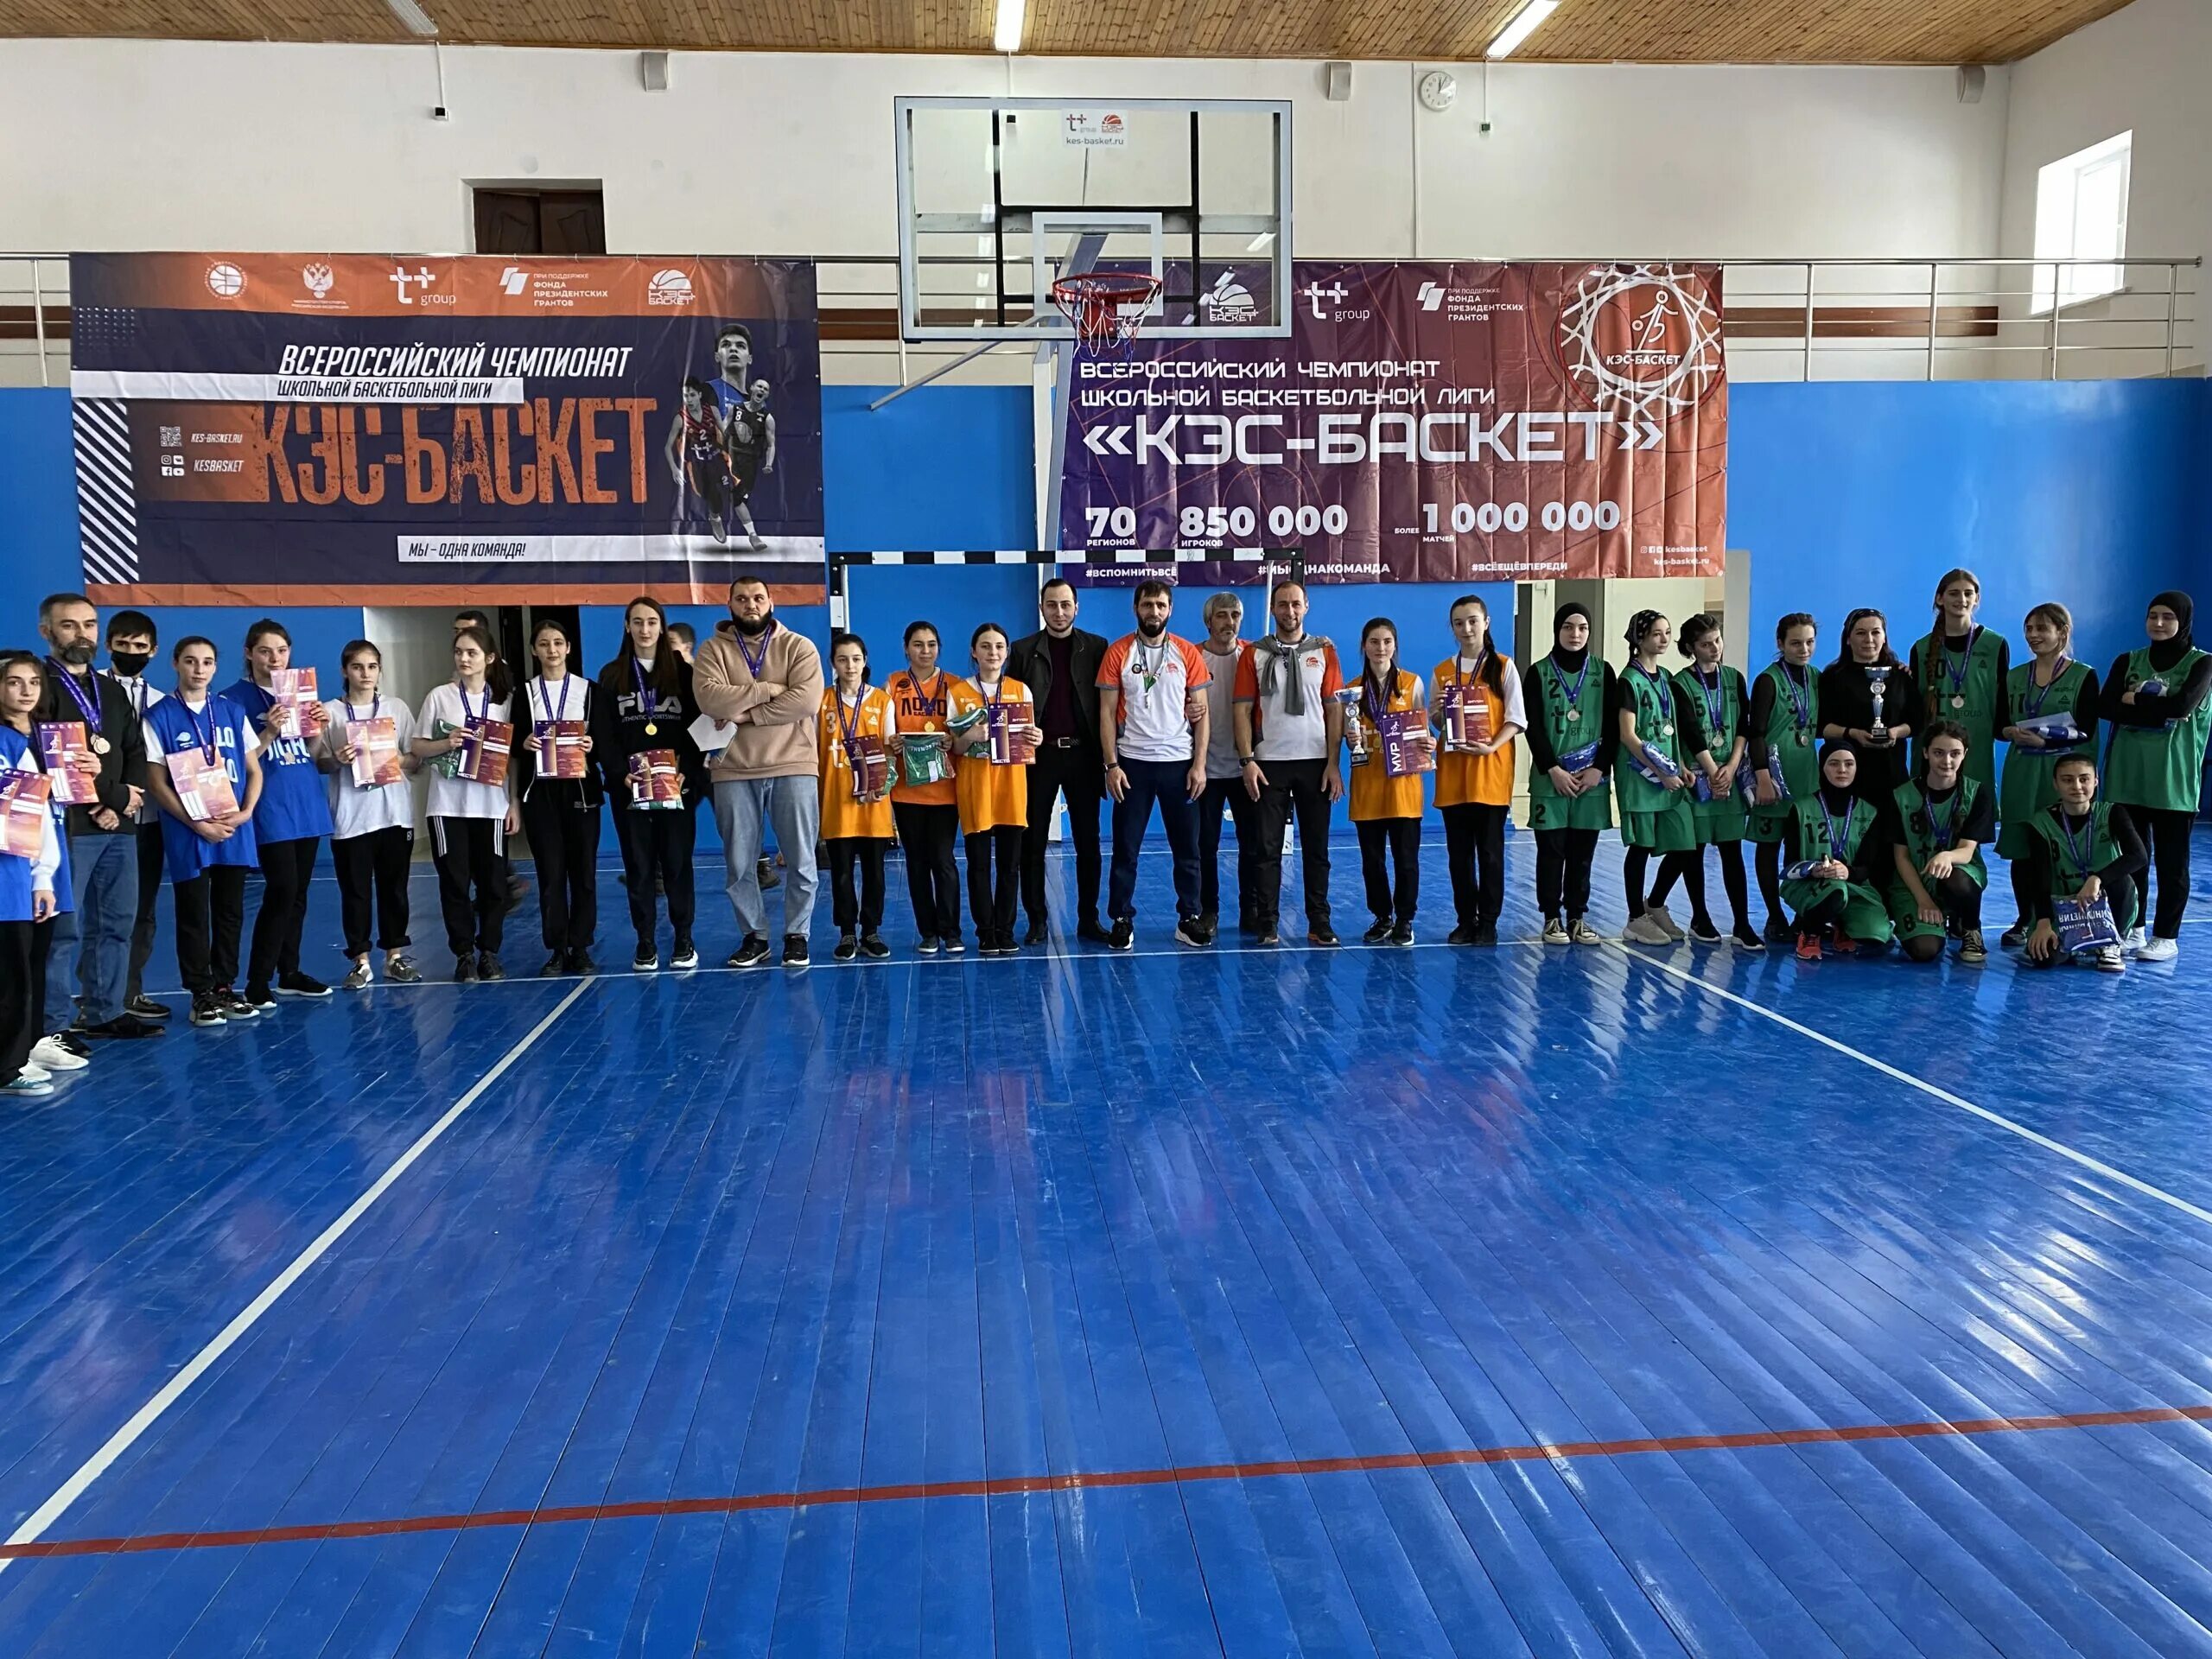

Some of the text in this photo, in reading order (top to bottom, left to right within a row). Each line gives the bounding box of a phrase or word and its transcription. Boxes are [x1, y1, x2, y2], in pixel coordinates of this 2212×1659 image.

[420, 294, 456, 306] group
[1447, 303, 1524, 312] ПРЕЗИДЕНТСКИХ
[1334, 308, 1370, 321] group
[278, 341, 632, 378] ВСЕРОССИЙСКИЙ ЧЕМПИОНАТ
[1080, 357, 1440, 378] ВСЕРОССИЙСКИЙ ЧЕМПИОНАТ
[1605, 353, 1681, 365] КЭС-БАСКЕТ
[276, 378, 492, 399] ШКОЛЬНОЙ БАСКЕТБОЛЬНОЙ ЛИГИ
[1081, 385, 1496, 407] ШКОЛЬНОЙ БАСКЕТБОЛЬНОЙ ЛИГИ
[191, 433, 243, 445] KES-BASKET.RU
[1083, 411, 1664, 465] «КЭС-БАСКЕТ»
[254, 397, 658, 505] КЭС-БАСКЕТ
[194, 459, 245, 473] KESBASKET
[1085, 505, 1136, 537] 70
[1179, 503, 1349, 537] 850 000
[1422, 500, 1620, 533] 1 000 000
[1086, 538, 1136, 547] РЕГИОНОВ
[1422, 534, 1455, 543] МАТЧЕЙ
[409, 543, 429, 557] МЫ
[439, 543, 469, 559] ОДНА
[471, 543, 526, 558] КОМАНДА!
[1085, 565, 1177, 577] #ВСПОМНИТЬВСЁ
[1471, 561, 1568, 572] #ВСЁЕЩЁВПЕРЕДИ
[1548, 677, 1560, 699] 2
[1640, 689, 1654, 710] 4
[1694, 696, 1706, 717] 5
[825, 711, 836, 734] 3
[1389, 742, 1402, 772] MVP
[1535, 804, 1547, 824] 2
[1759, 818, 1771, 836] 3
[1804, 822, 1830, 844] 12
[1903, 913, 1916, 932] 8
